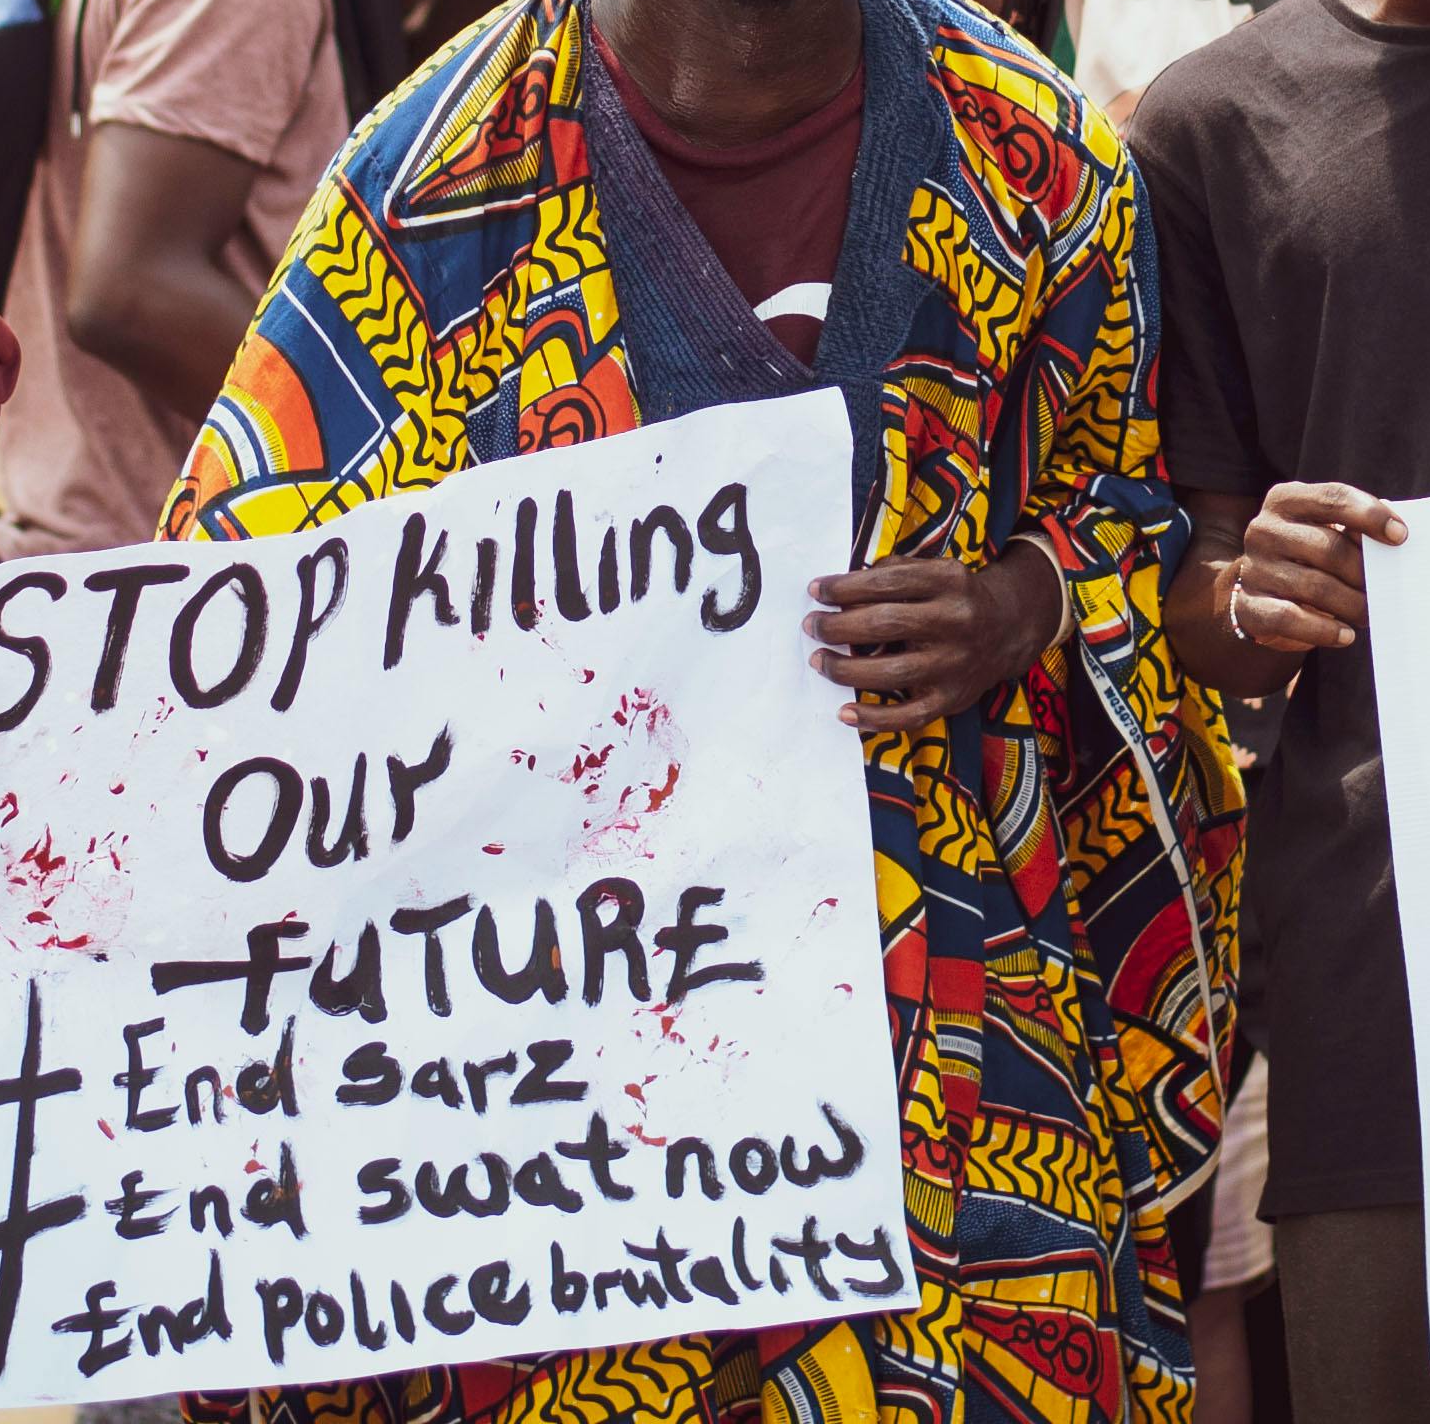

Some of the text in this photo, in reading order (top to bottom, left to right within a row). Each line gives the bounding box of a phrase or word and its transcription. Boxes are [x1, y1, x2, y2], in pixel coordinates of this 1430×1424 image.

[113, 1014, 303, 1132] End
[104, 1097, 867, 1240] End swat now
[51, 1214, 910, 1378] End police brutality
